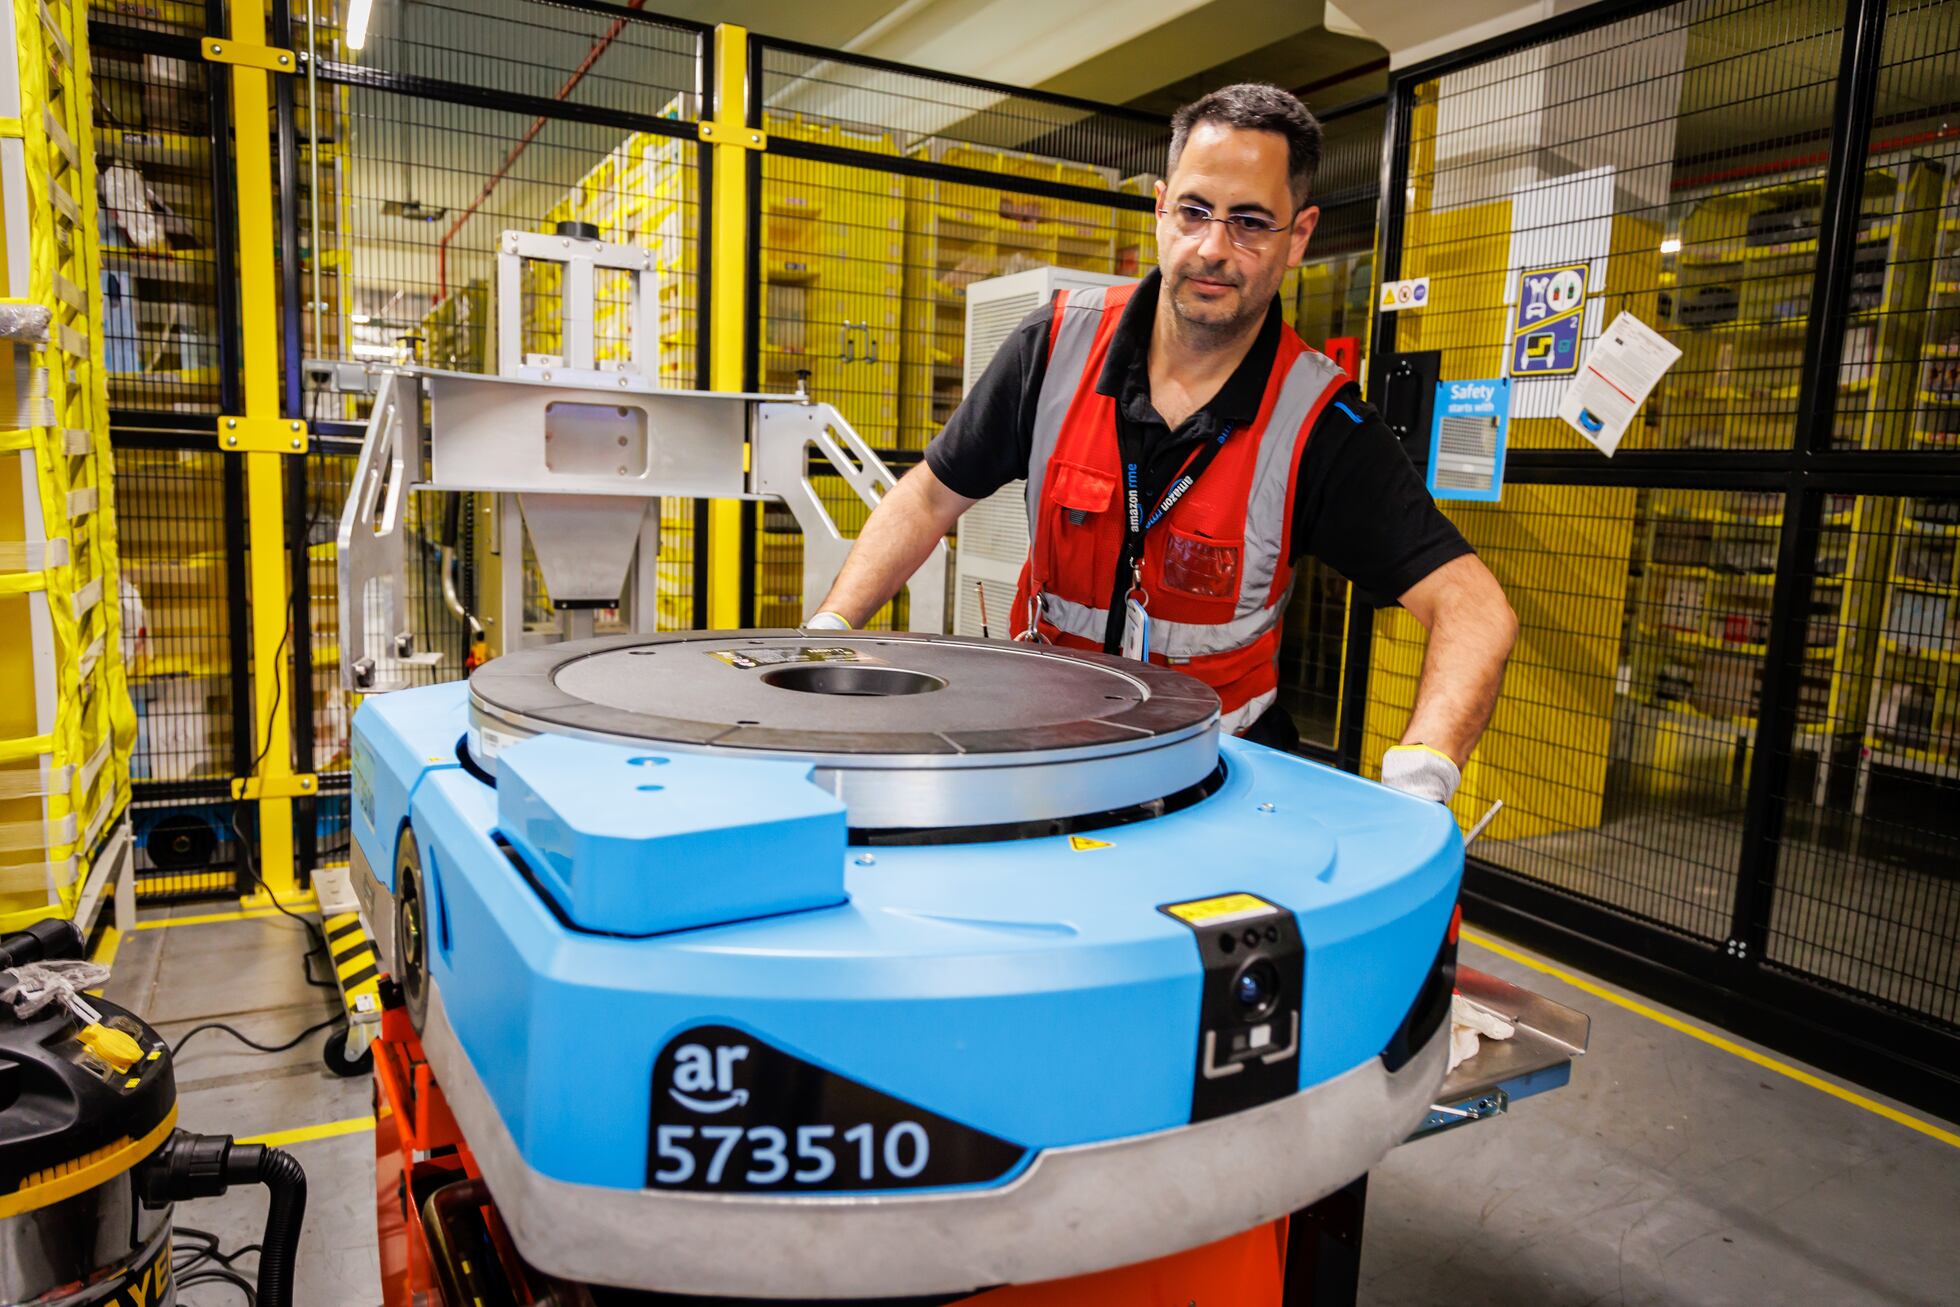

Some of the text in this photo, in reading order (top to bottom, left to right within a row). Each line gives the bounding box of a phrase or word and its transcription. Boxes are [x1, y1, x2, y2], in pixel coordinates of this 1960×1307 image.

[1569, 316, 1579, 329] 2
[1450, 384, 1496, 402] Safety
[1128, 463, 1140, 533] amazon rme
[1160, 475, 1194, 512] amazon
[673, 1043, 750, 1093] ar
[654, 1120, 931, 1184] 573510
